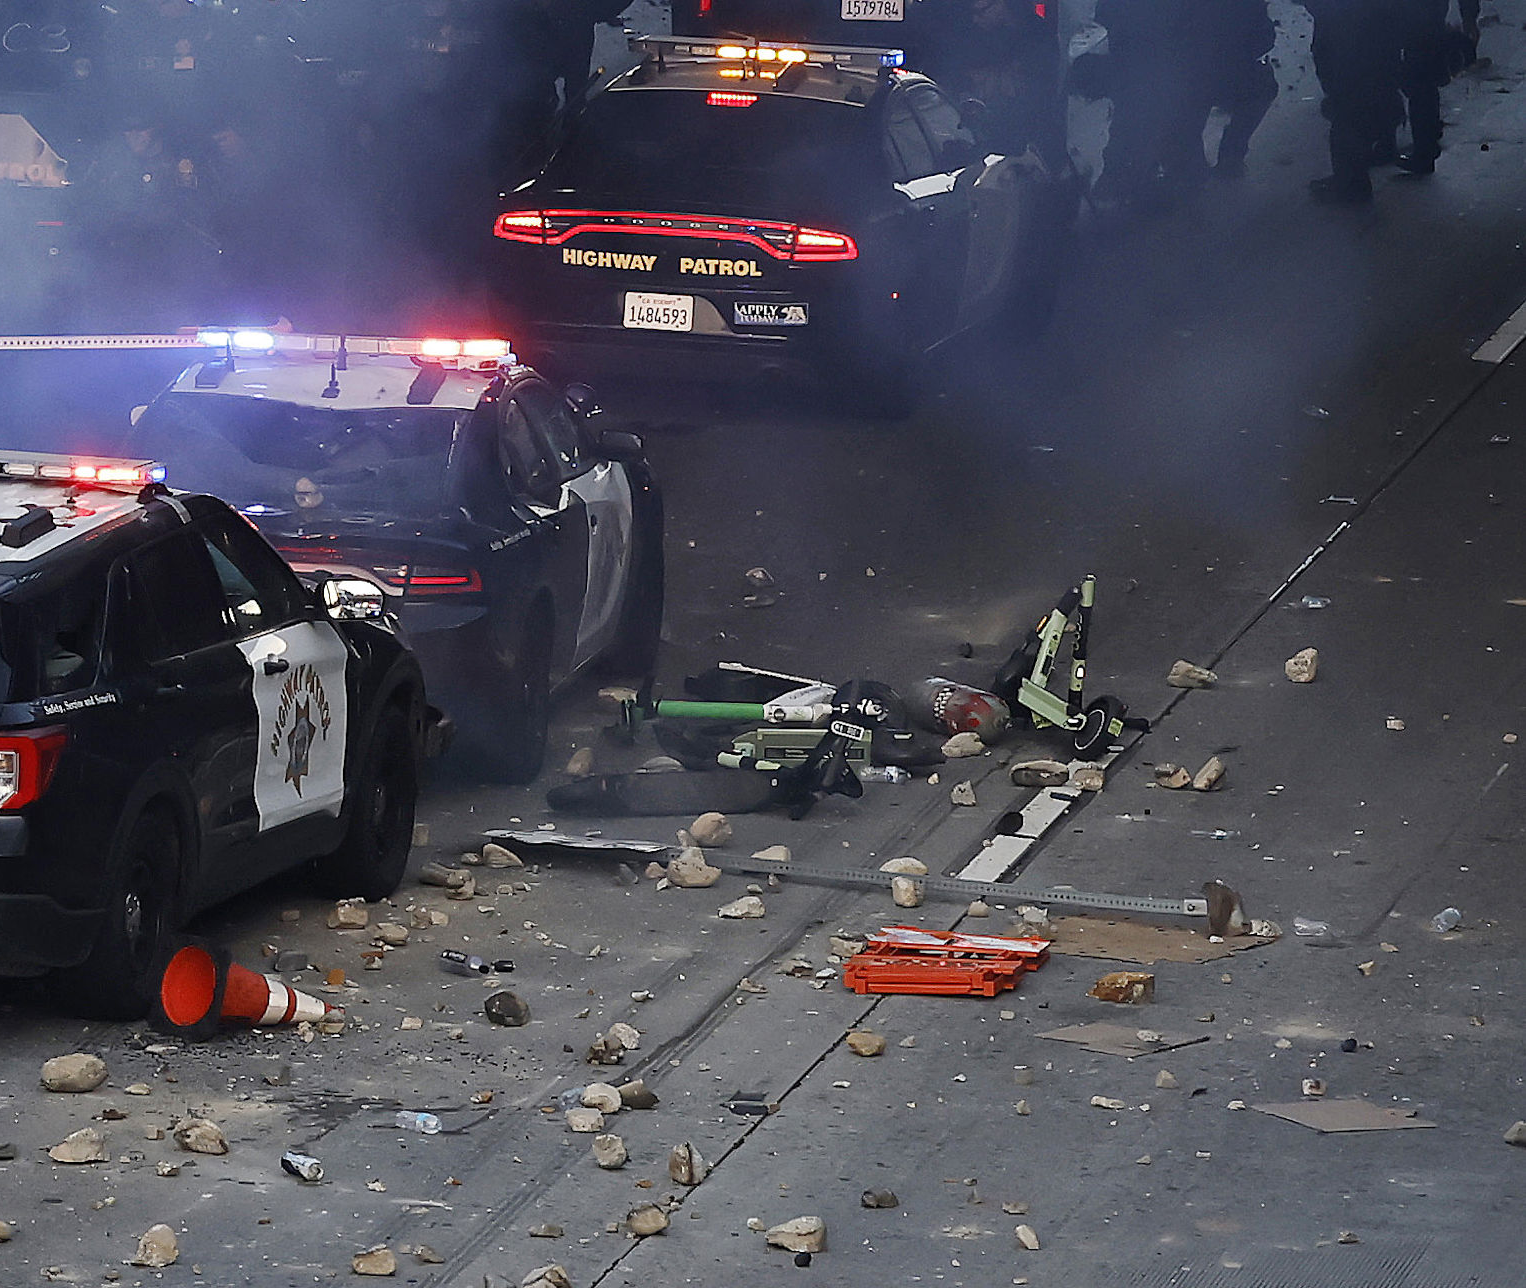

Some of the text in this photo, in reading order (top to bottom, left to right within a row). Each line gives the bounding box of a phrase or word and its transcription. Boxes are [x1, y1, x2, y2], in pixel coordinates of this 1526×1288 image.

[846, 0, 898, 16] 1579784
[562, 248, 763, 277] HIGHWAY PATROL
[629, 305, 688, 325] 1484593
[739, 304, 779, 316] APPLY
